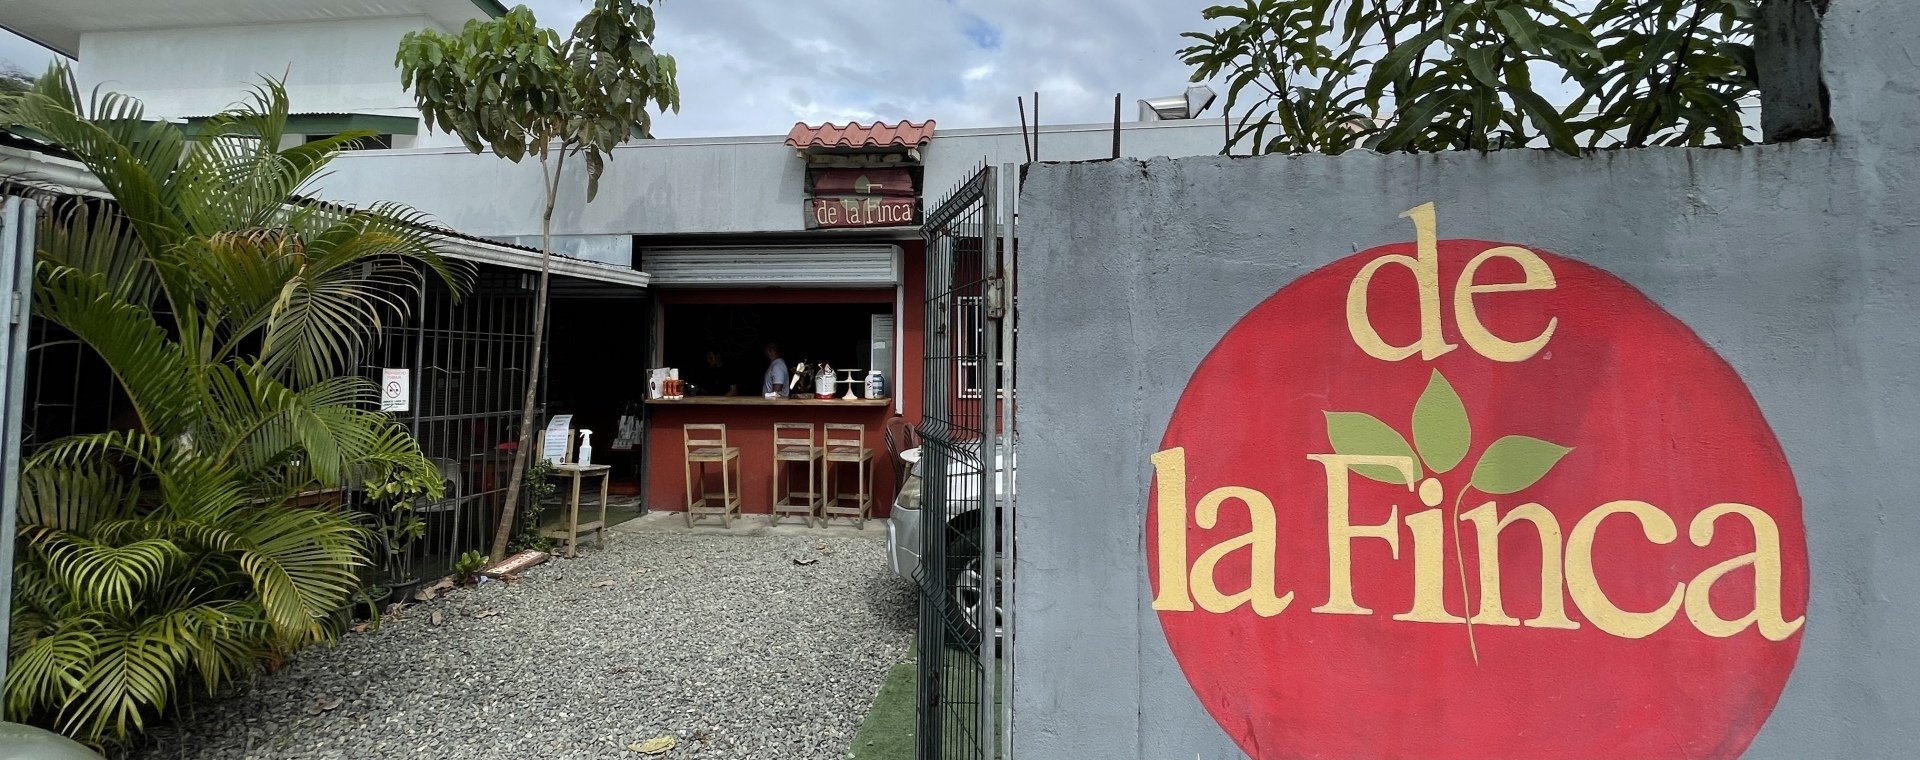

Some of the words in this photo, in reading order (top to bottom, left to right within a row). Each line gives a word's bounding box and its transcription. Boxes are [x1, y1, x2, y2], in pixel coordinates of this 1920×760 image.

[817, 200, 837, 224] de
[844, 199, 860, 224] la
[866, 184, 912, 224] Finca
[1346, 202, 1557, 362] de
[1150, 447, 1294, 617] la
[1307, 453, 1805, 641] Finca
